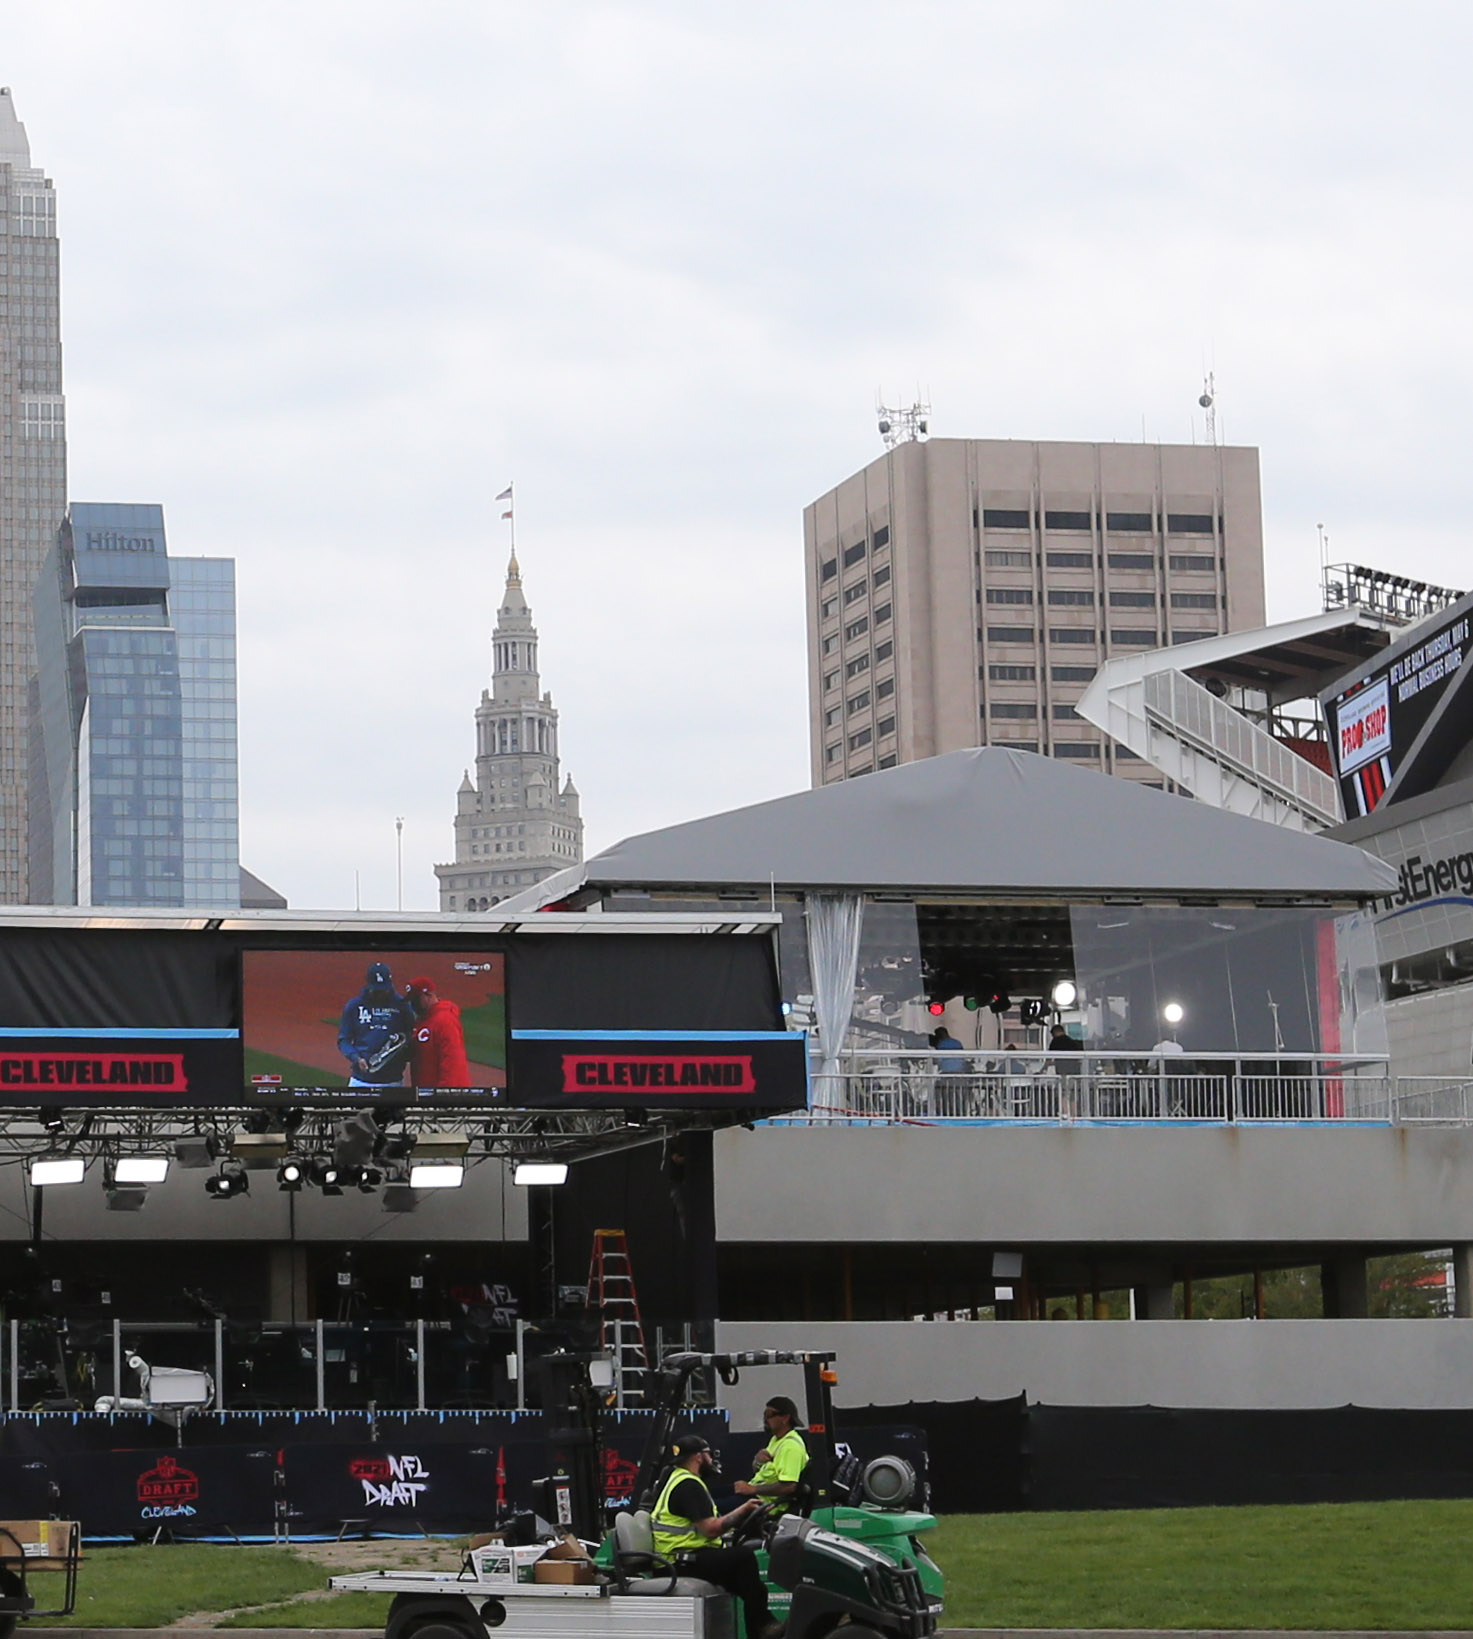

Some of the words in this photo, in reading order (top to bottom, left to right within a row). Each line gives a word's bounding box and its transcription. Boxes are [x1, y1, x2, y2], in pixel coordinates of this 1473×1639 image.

[86, 531, 155, 552] Hilton
[1404, 656, 1411, 677] BE
[1411, 647, 1425, 672] BACK
[1452, 622, 1464, 646] MAY
[1464, 618, 1469, 638] 6
[1419, 658, 1444, 691] BUSINESS
[1444, 647, 1462, 674] HOURS
[1341, 723, 1358, 760] PRO
[1365, 704, 1386, 741] SHOP
[1371, 851, 1473, 914] stEnerg
[358, 1006, 372, 1024] LA
[0, 1059, 174, 1085] CLEVELAND
[575, 1062, 743, 1086] CLEVELAND
[482, 1284, 518, 1305] NFL
[388, 1454, 430, 1481] NFL
[143, 1483, 192, 1495] DRAFT
[362, 1479, 426, 1507] DRAFT
[141, 1504, 197, 1518] CLEVELAND
